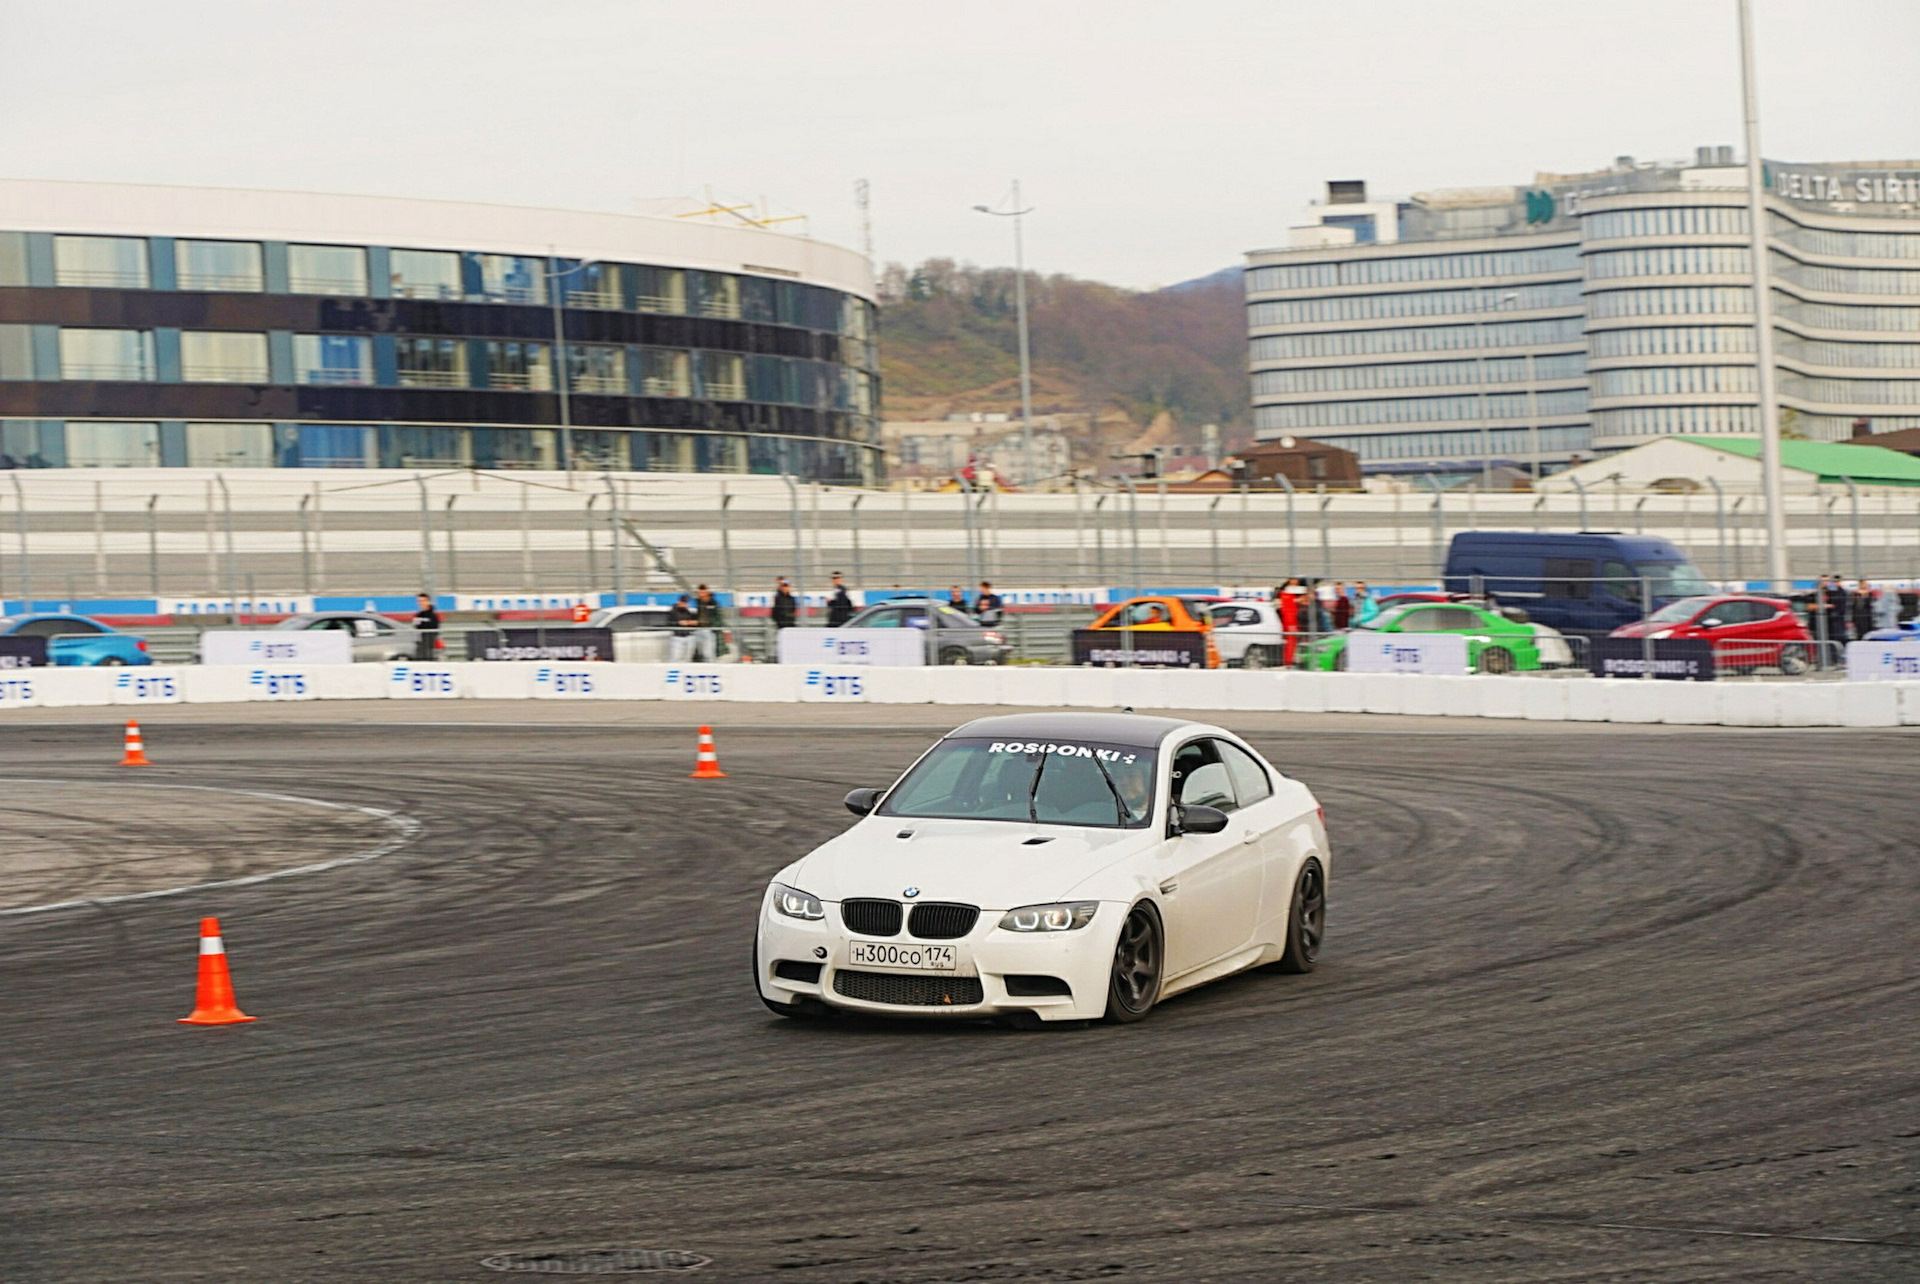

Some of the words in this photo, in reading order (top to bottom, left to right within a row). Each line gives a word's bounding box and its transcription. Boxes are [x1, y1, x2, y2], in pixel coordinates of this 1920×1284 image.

[1778, 173, 1843, 200] DELTA
[1856, 178, 1920, 202] SIRI
[925, 947, 951, 961] 174
